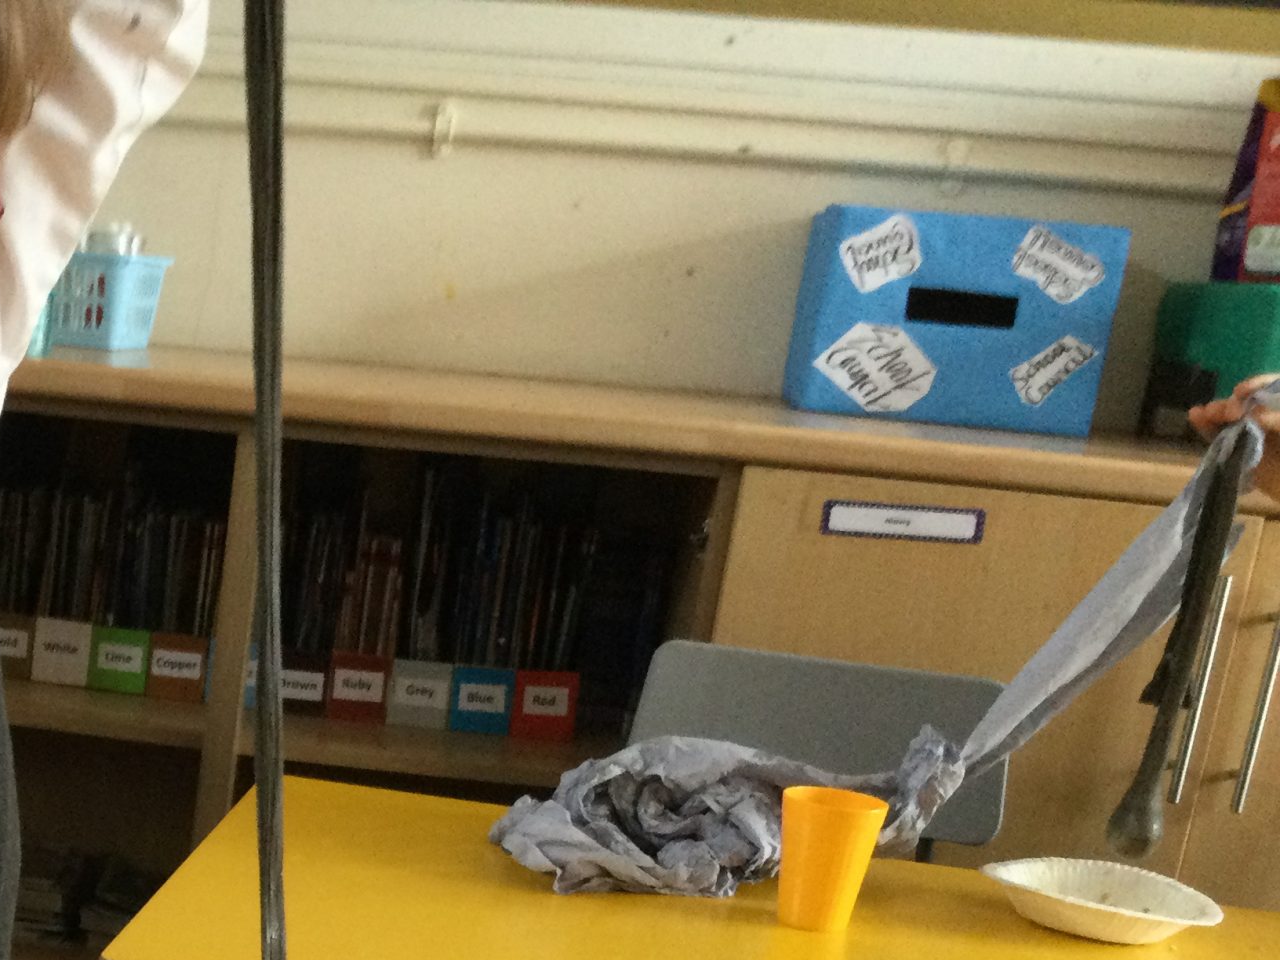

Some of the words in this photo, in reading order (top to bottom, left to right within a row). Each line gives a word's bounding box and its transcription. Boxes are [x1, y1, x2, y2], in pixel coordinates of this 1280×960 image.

[156, 657, 197, 671] Copper
[405, 683, 434, 699] Grey
[466, 691, 494, 704] Blue
[531, 695, 557, 707] Red
